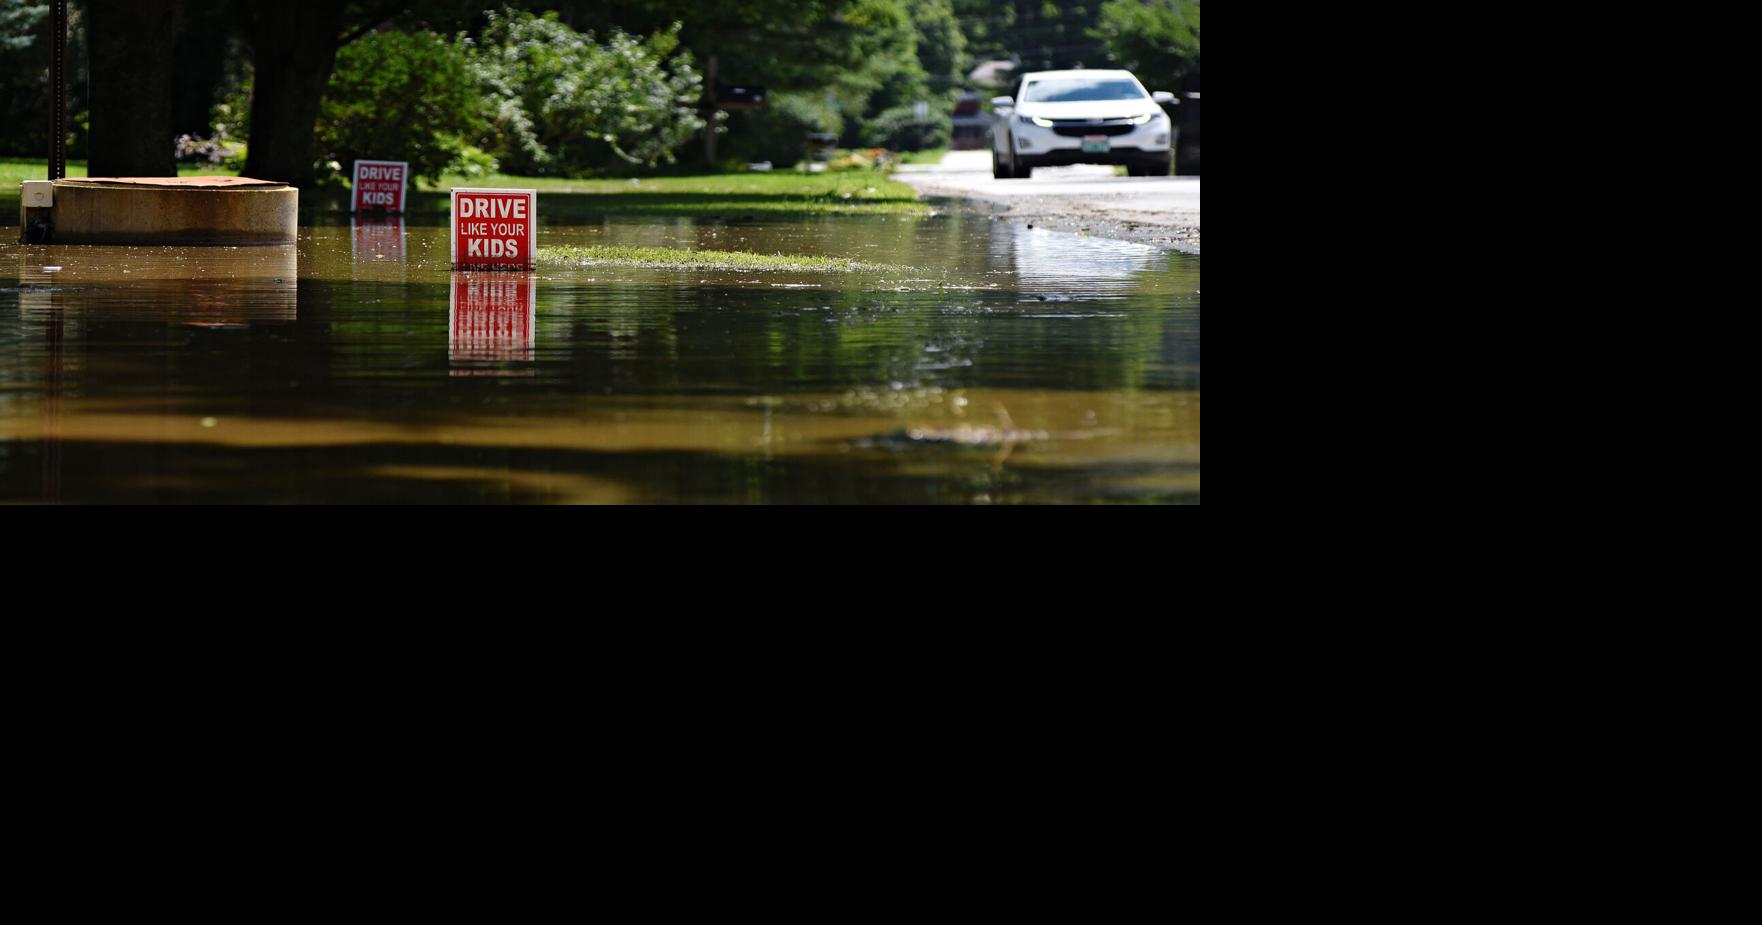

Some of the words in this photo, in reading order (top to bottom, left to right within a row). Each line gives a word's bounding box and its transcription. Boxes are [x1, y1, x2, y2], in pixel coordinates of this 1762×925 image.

[360, 167, 400, 180] DRIVE
[363, 192, 394, 205] KIDS
[460, 198, 526, 219] DRIVE
[461, 223, 487, 235] LIKE
[491, 223, 525, 236] YOUR
[468, 238, 518, 258] KIDS
